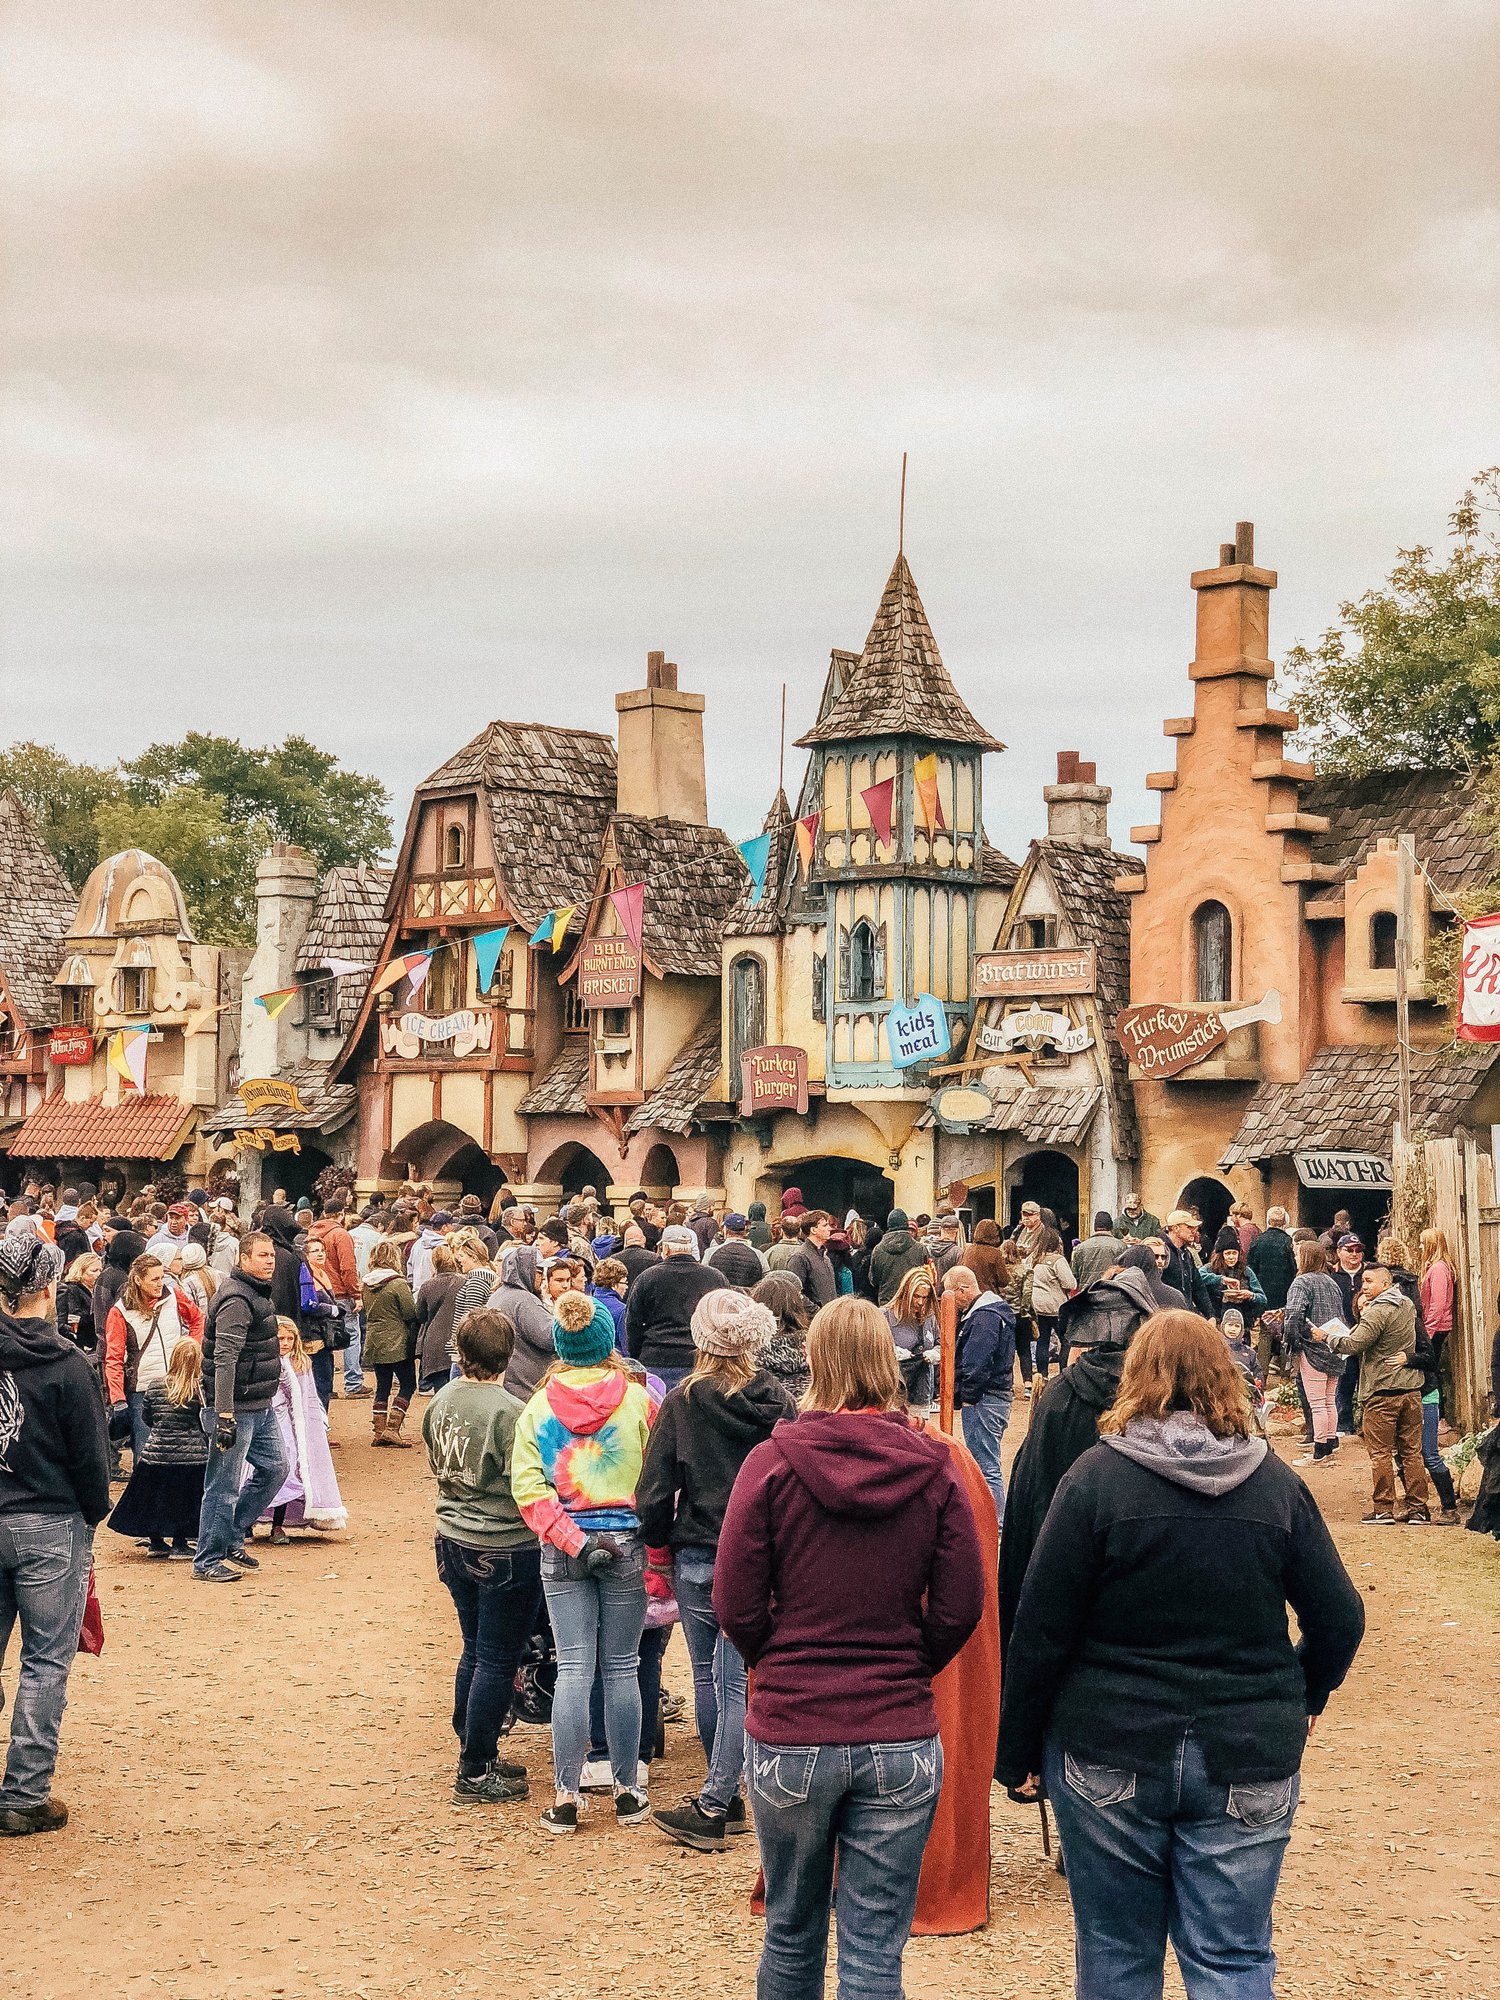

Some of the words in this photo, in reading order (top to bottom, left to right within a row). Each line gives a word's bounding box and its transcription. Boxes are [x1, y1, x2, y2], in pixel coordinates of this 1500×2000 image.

[593, 942, 627, 956] BBQ
[583, 956, 613, 974] BURNT
[614, 954, 637, 970] ENDS
[977, 959, 1089, 984] Bratwurst
[583, 977, 635, 996] BRISKET
[406, 1015, 426, 1036] ICE
[430, 1013, 471, 1039] CREAM
[895, 1010, 935, 1037] kids
[1123, 1008, 1189, 1046] Turkey
[899, 1028, 939, 1057] meal
[1137, 1011, 1222, 1071] Drumstick
[751, 1052, 797, 1079] Turkey
[263, 1081, 293, 1104] Rings
[753, 1078, 798, 1101] Burger
[237, 1131, 260, 1145] Foot
[1299, 1157, 1393, 1184] WATER
